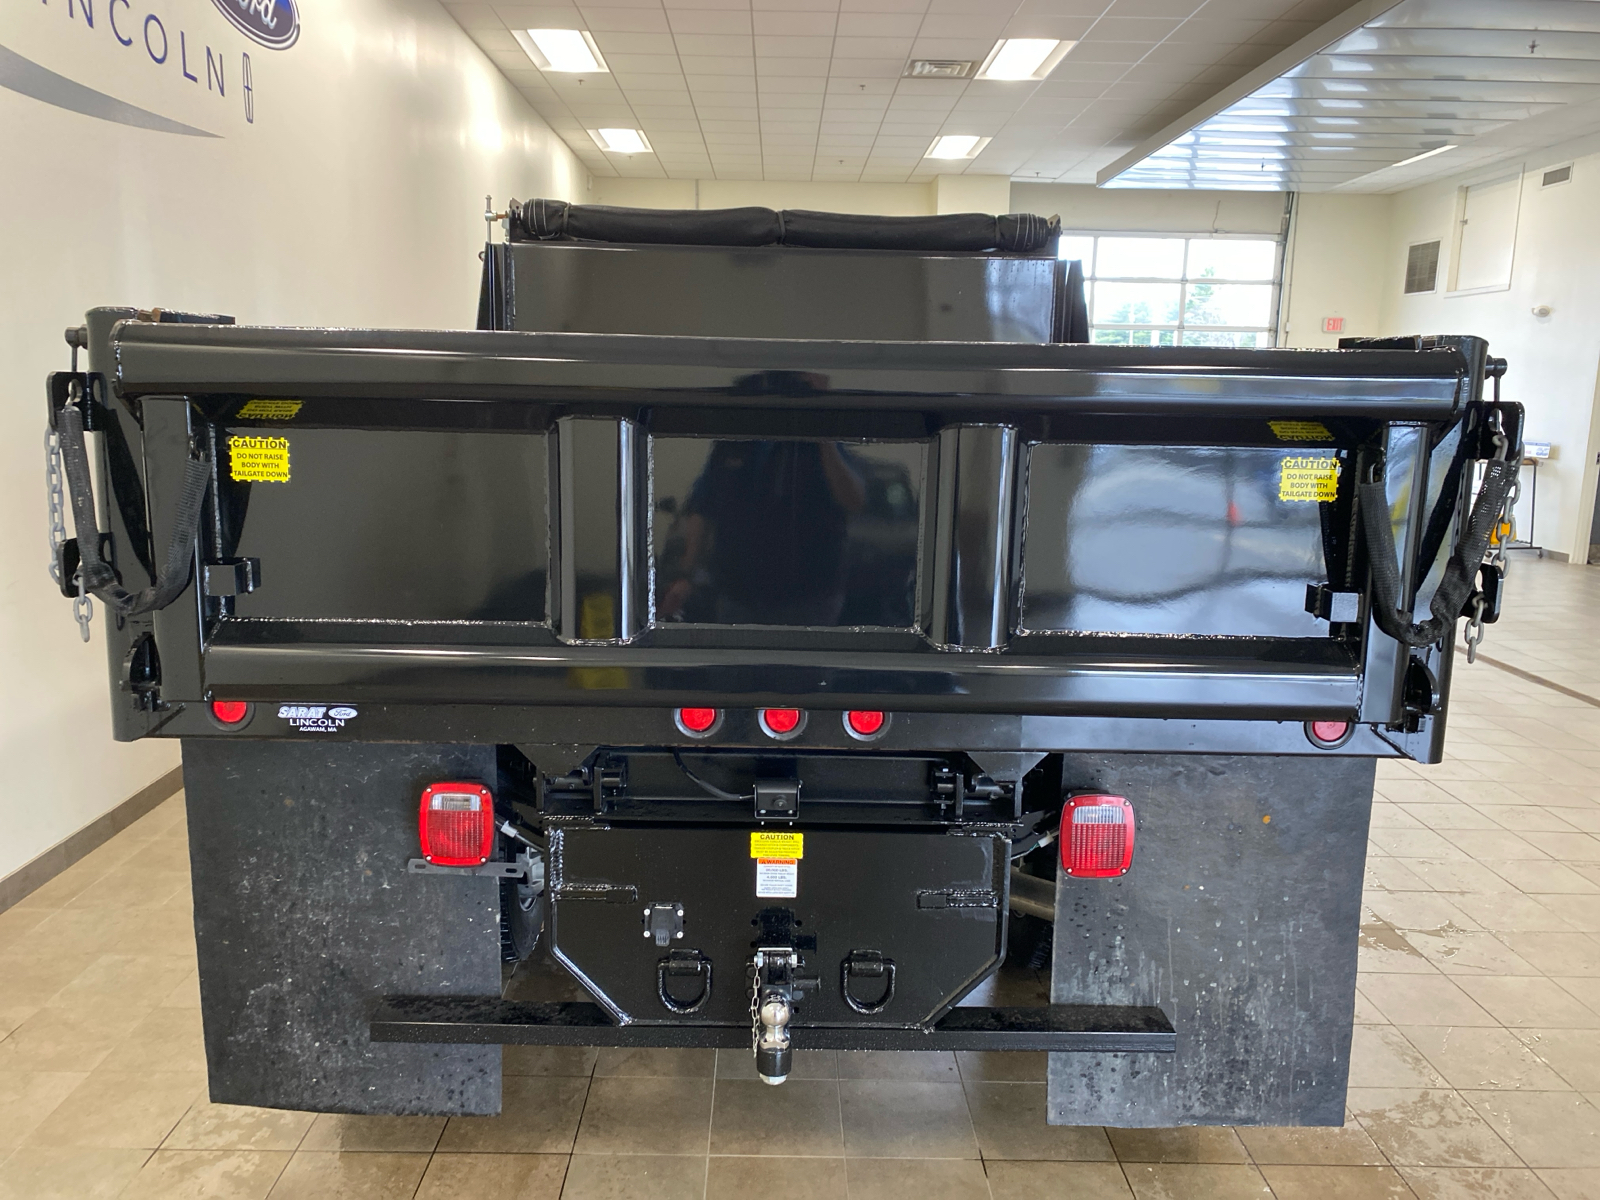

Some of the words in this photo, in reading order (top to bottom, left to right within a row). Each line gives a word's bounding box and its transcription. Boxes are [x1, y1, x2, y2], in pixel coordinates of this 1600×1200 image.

[1326, 317, 1343, 331] EXIT
[232, 439, 287, 449] CAUTION
[1284, 460, 1337, 469] CAUTION
[278, 706, 326, 718] SARAT
[289, 718, 345, 727] LINCOLN
